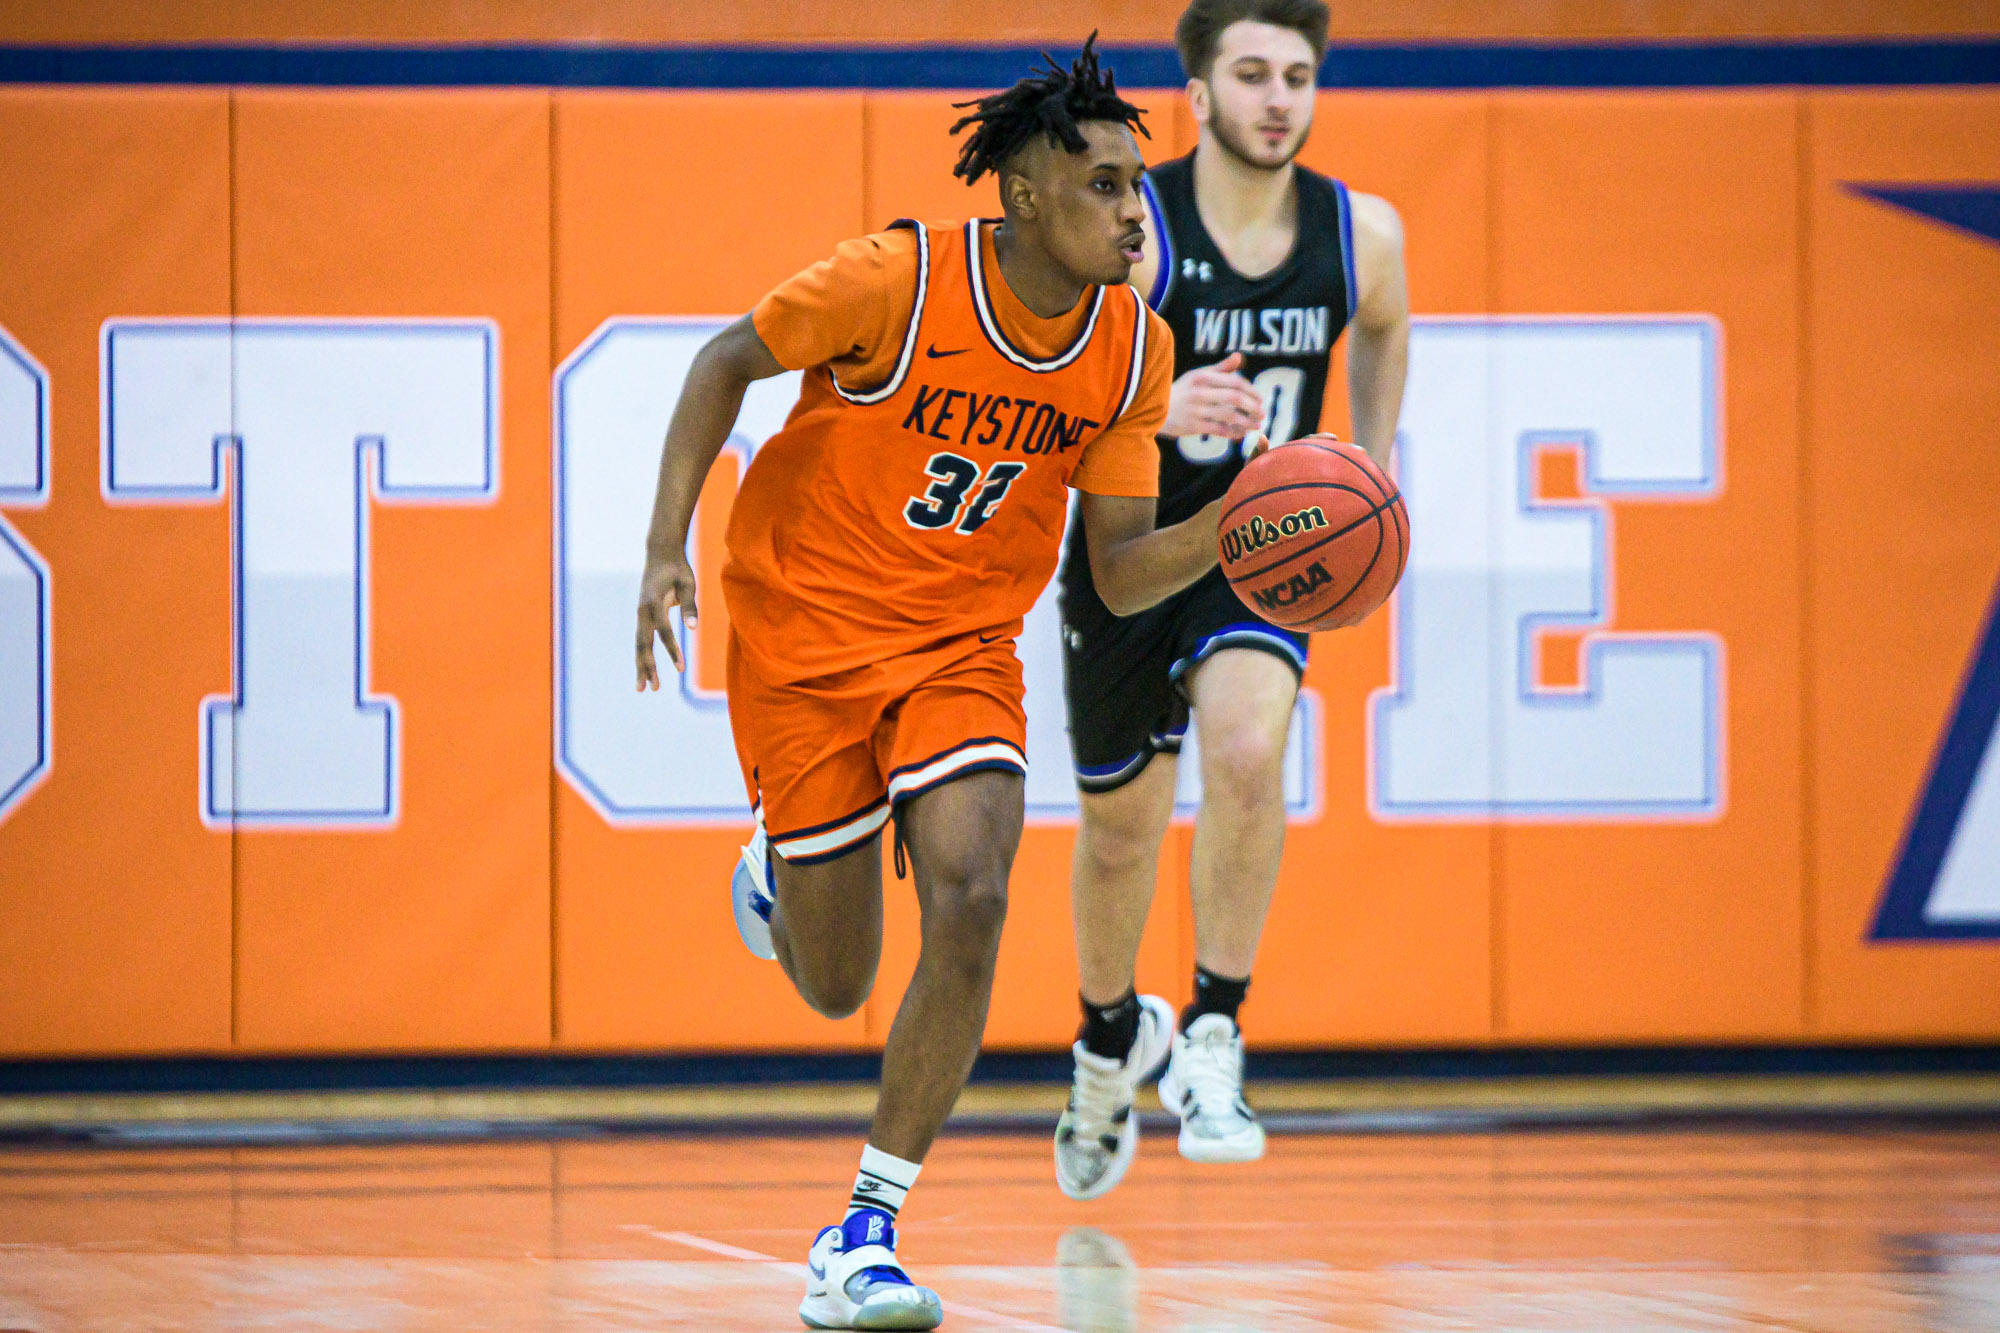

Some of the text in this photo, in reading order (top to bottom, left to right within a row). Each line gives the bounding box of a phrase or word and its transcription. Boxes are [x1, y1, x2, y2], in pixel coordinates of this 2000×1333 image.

[1193, 306, 1331, 355] WILSON
[1220, 505, 1329, 565] Wilson
[1251, 560, 1334, 611] NCAA
